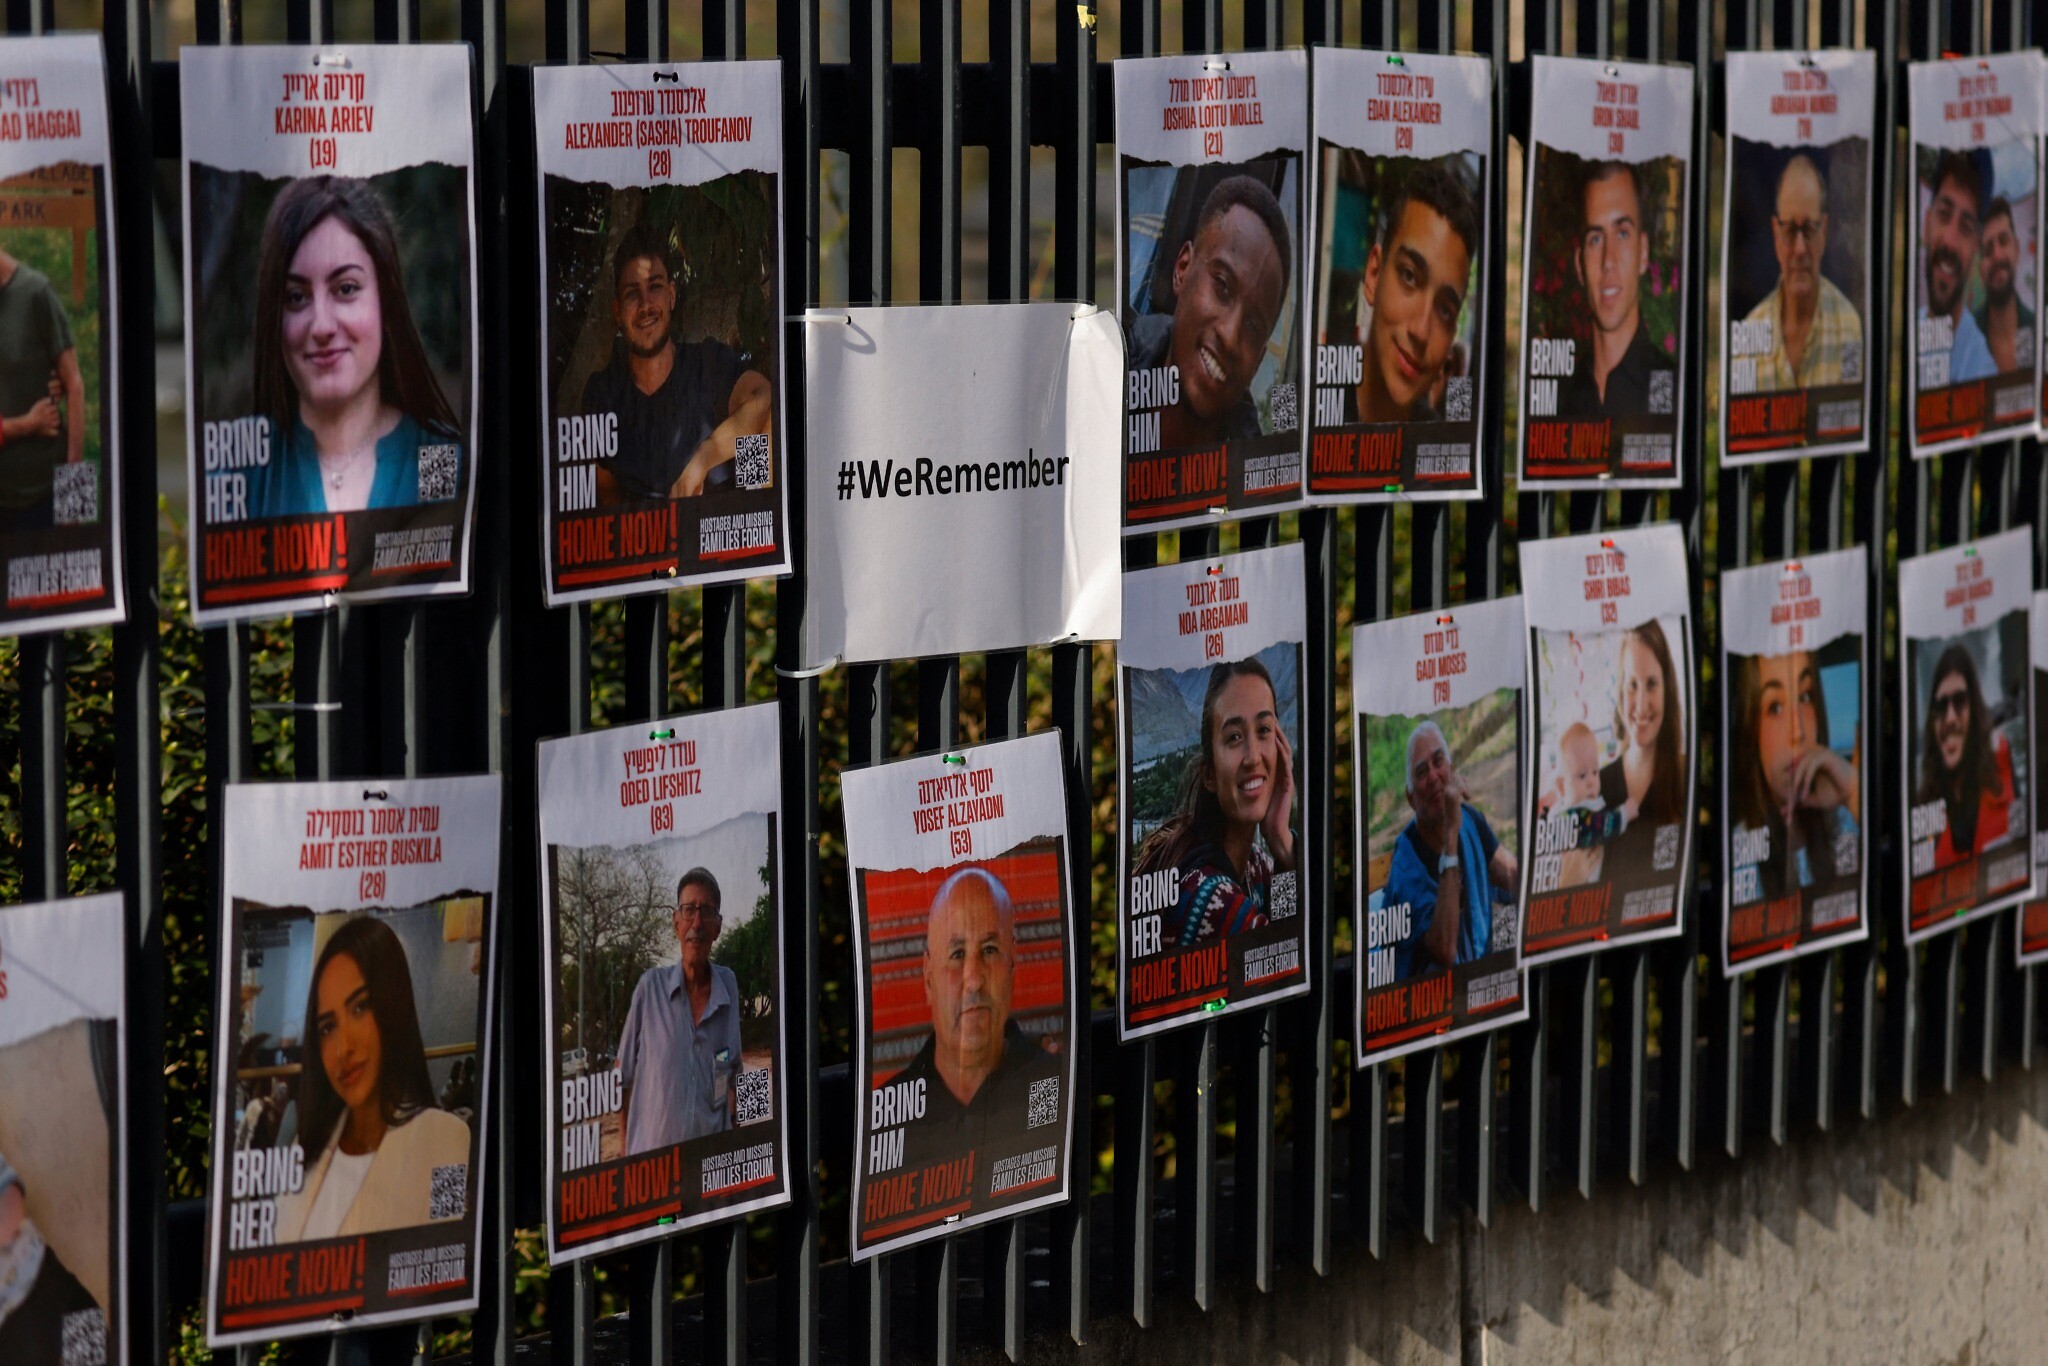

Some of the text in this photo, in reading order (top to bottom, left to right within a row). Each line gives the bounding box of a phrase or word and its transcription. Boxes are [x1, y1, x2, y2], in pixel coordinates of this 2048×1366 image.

[282, 73, 364, 103] קרינה ארייב
[611, 87, 706, 117] אלכסנדר טרופנוב
[25, 109, 81, 140] HAGGAI
[275, 106, 373, 134] KARINA ARIEV
[1163, 102, 1263, 131] JOSHUA LOITU MOLLEL
[1368, 99, 1441, 124] EDAN ALEXANDER
[566, 117, 752, 150] ALEXANDER (SASHA) TROUFANOV
[1204, 130, 1222, 158] (21)
[1396, 126, 1413, 151] (20)
[311, 137, 336, 169] (19)
[649, 149, 671, 179] (28)
[1316, 346, 1363, 385] BRING
[1531, 338, 1575, 376] BRING
[1128, 365, 1180, 410] BRING
[1530, 379, 1558, 416] HIM
[1315, 388, 1345, 427] HIM
[204, 417, 270, 471] BRING
[557, 412, 618, 463] BRING
[1128, 411, 1160, 454] HIM
[1313, 428, 1403, 473] HOME NOW!
[1528, 423, 1568, 459] HOME
[1571, 417, 1611, 459] NOW!
[559, 464, 596, 512] HIM
[838, 448, 1069, 500] #WeRemember
[1128, 444, 1227, 502] HOME NOW!
[1244, 465, 1300, 491] FAMILIES FORUM
[205, 473, 247, 524] HER
[558, 502, 677, 566] HOME NOW!
[700, 511, 773, 532] HOSTAGES AND MISSING
[700, 526, 774, 554] FAMILIES FORUM
[205, 514, 348, 582] HOME NOW!
[373, 540, 451, 571] FAMILIES FORUM
[61, 565, 102, 594] FORUM
[1219, 577, 1239, 601] נועה
[1607, 576, 1630, 598] BIBAS
[1179, 602, 1248, 636] NOA ARGAMANI
[1206, 632, 1223, 660] (26)
[1416, 652, 1467, 682] GADI MOSES
[1434, 679, 1450, 705] (79)
[624, 740, 696, 779] עודד ליפשיץ
[620, 769, 701, 808] ODED LIFSHITZ
[970, 767, 993, 795] יוסף
[369, 808, 405, 834] אסתר
[651, 802, 673, 835] (83)
[913, 794, 1004, 834] YOSEF ALZAYADNI
[300, 837, 441, 870] AMIT ESTHER BUSKILA
[950, 828, 972, 858] (53)
[1536, 813, 1579, 856] BRING
[360, 870, 386, 902] (28)
[1131, 867, 1179, 916] BRING
[1532, 855, 1561, 895] HER
[1369, 902, 1411, 949] BRING
[1528, 895, 1568, 936] HOME
[1569, 881, 1612, 925] NOW!
[1132, 915, 1162, 959] HER
[1131, 939, 1227, 1006] HOME NOW!
[1245, 950, 1299, 982] FAMILIES FORUM
[1368, 947, 1395, 990] HIM
[1367, 986, 1407, 1034] HOME
[1411, 970, 1452, 1020] NOW!
[562, 1067, 623, 1124] BRING
[871, 1077, 926, 1130] BRING
[562, 1123, 601, 1173] HIM
[702, 1142, 773, 1172] HOSTAGES AND MISSING
[869, 1128, 904, 1175] HIM
[993, 1145, 1057, 1171] HOSTAGES AND MISSING
[232, 1145, 304, 1198] BRING
[561, 1146, 680, 1224] HOME NOW!
[702, 1158, 774, 1194] FAMILIES FORUM
[865, 1150, 975, 1223] HOME NOW!
[991, 1159, 1056, 1193] FAMILIES FORUM
[229, 1199, 276, 1250] HER
[226, 1236, 366, 1306] HOME NOW!
[388, 1259, 465, 1291] FAMILIES FORUM
